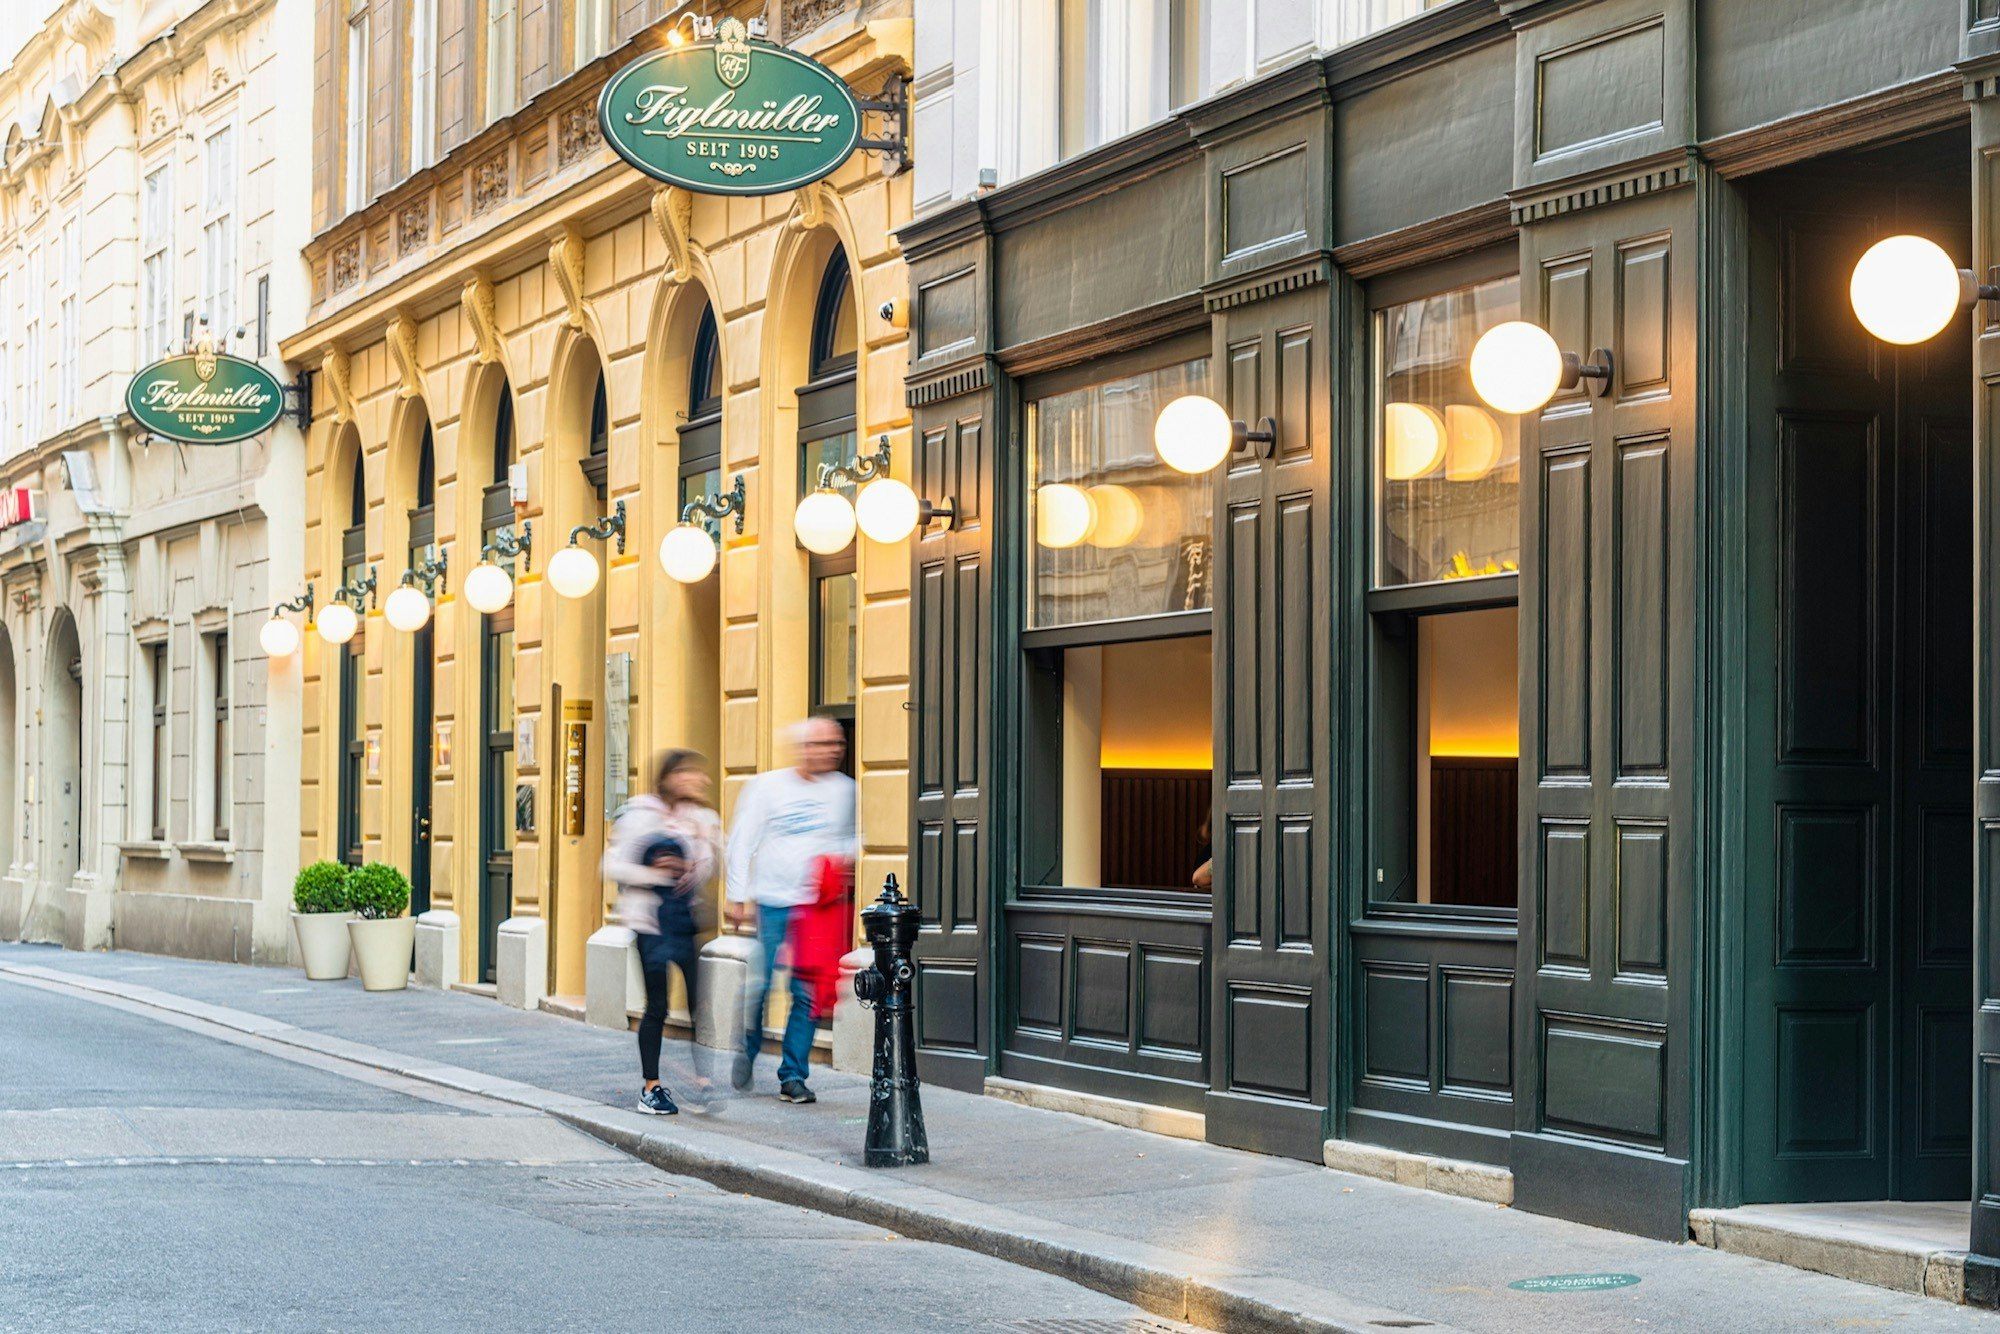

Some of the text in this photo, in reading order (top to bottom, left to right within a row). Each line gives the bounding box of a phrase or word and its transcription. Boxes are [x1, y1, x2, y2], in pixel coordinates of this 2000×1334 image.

[625, 84, 840, 140] Figlmüller
[686, 141, 780, 160] SEIT 1905
[140, 379, 271, 413] Figlmüller
[178, 413, 235, 424] SEIT 1905
